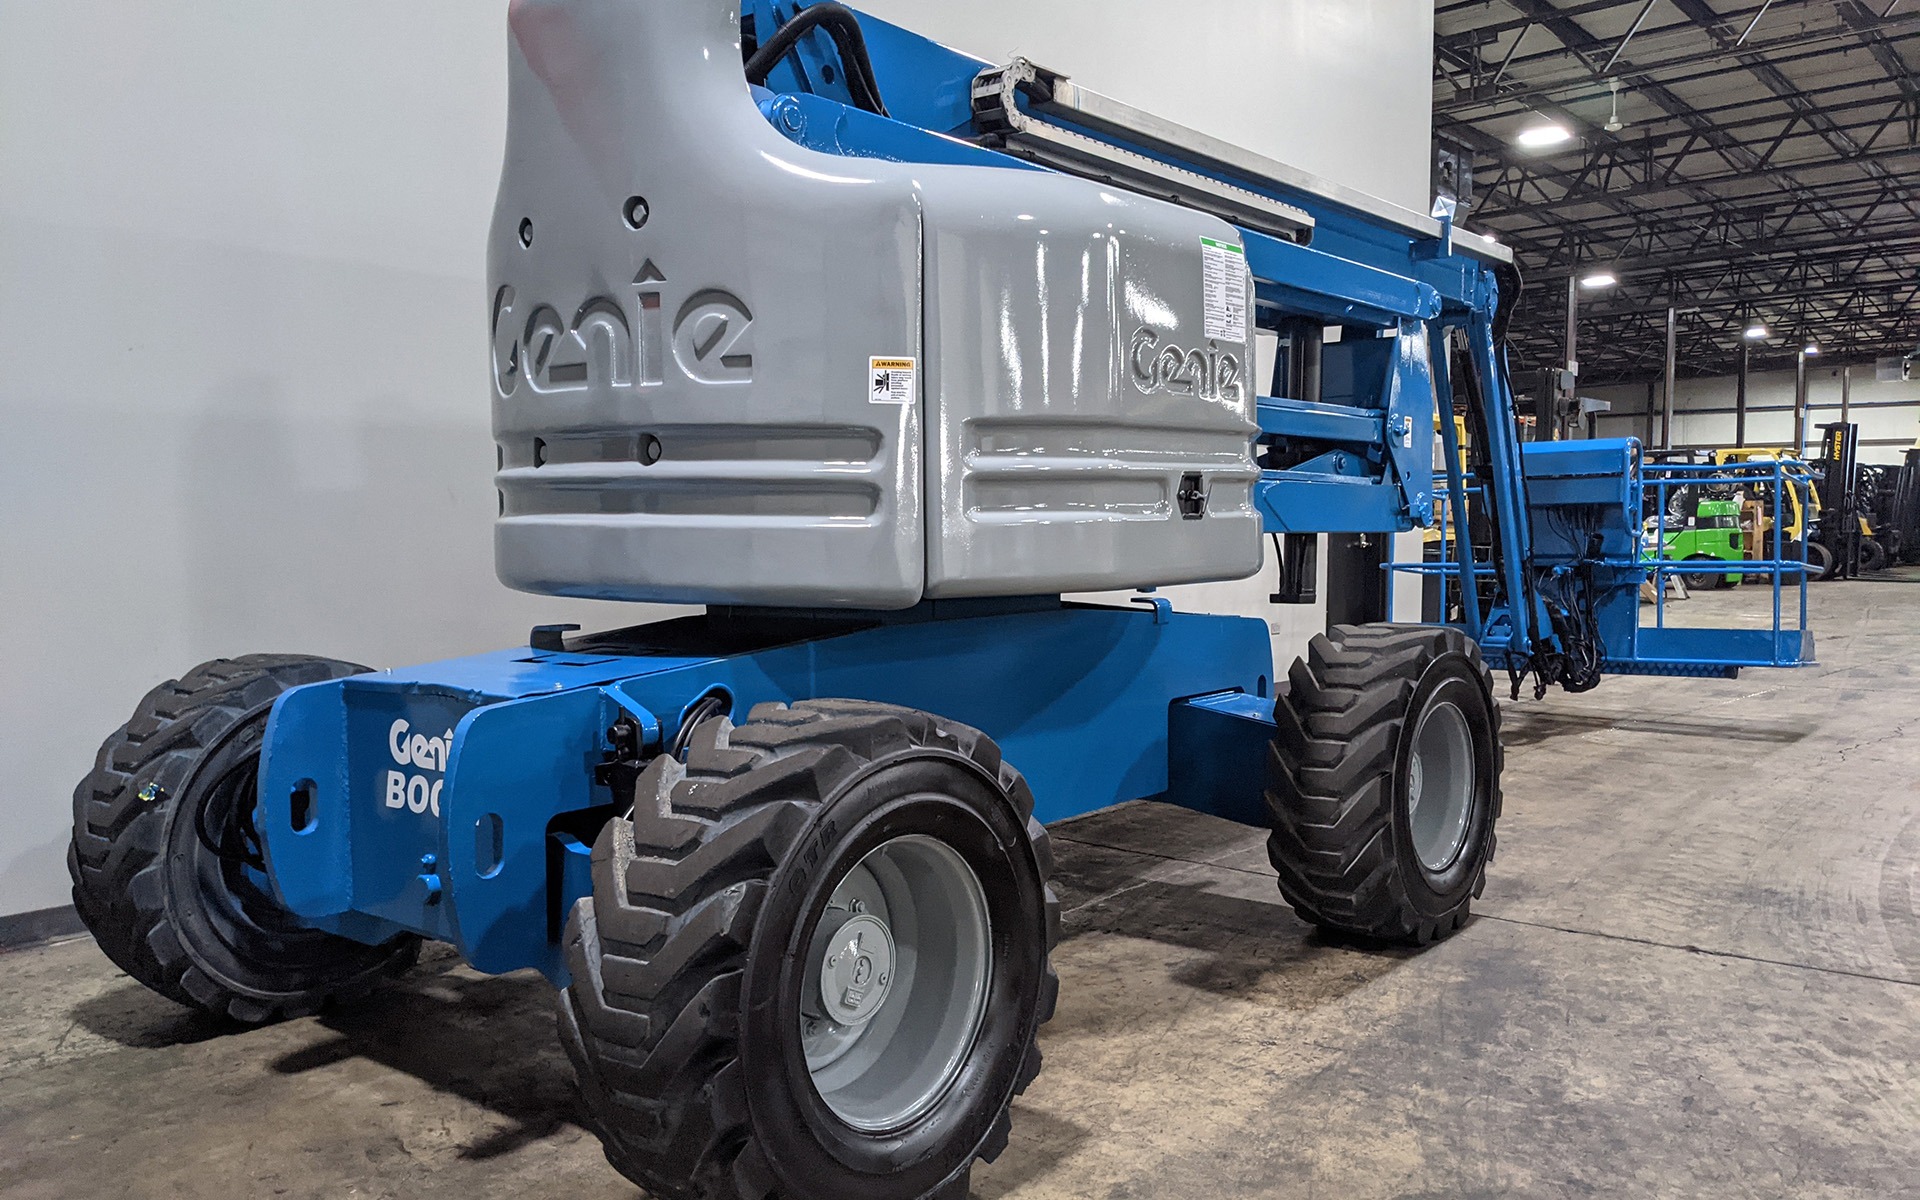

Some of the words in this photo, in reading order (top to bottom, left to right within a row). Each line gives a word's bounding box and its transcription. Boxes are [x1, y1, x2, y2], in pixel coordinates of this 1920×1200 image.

[492, 258, 753, 399] Genie
[1131, 326, 1241, 401] Genie
[1833, 431, 1842, 461] HYSTER
[389, 718, 455, 772] Geni
